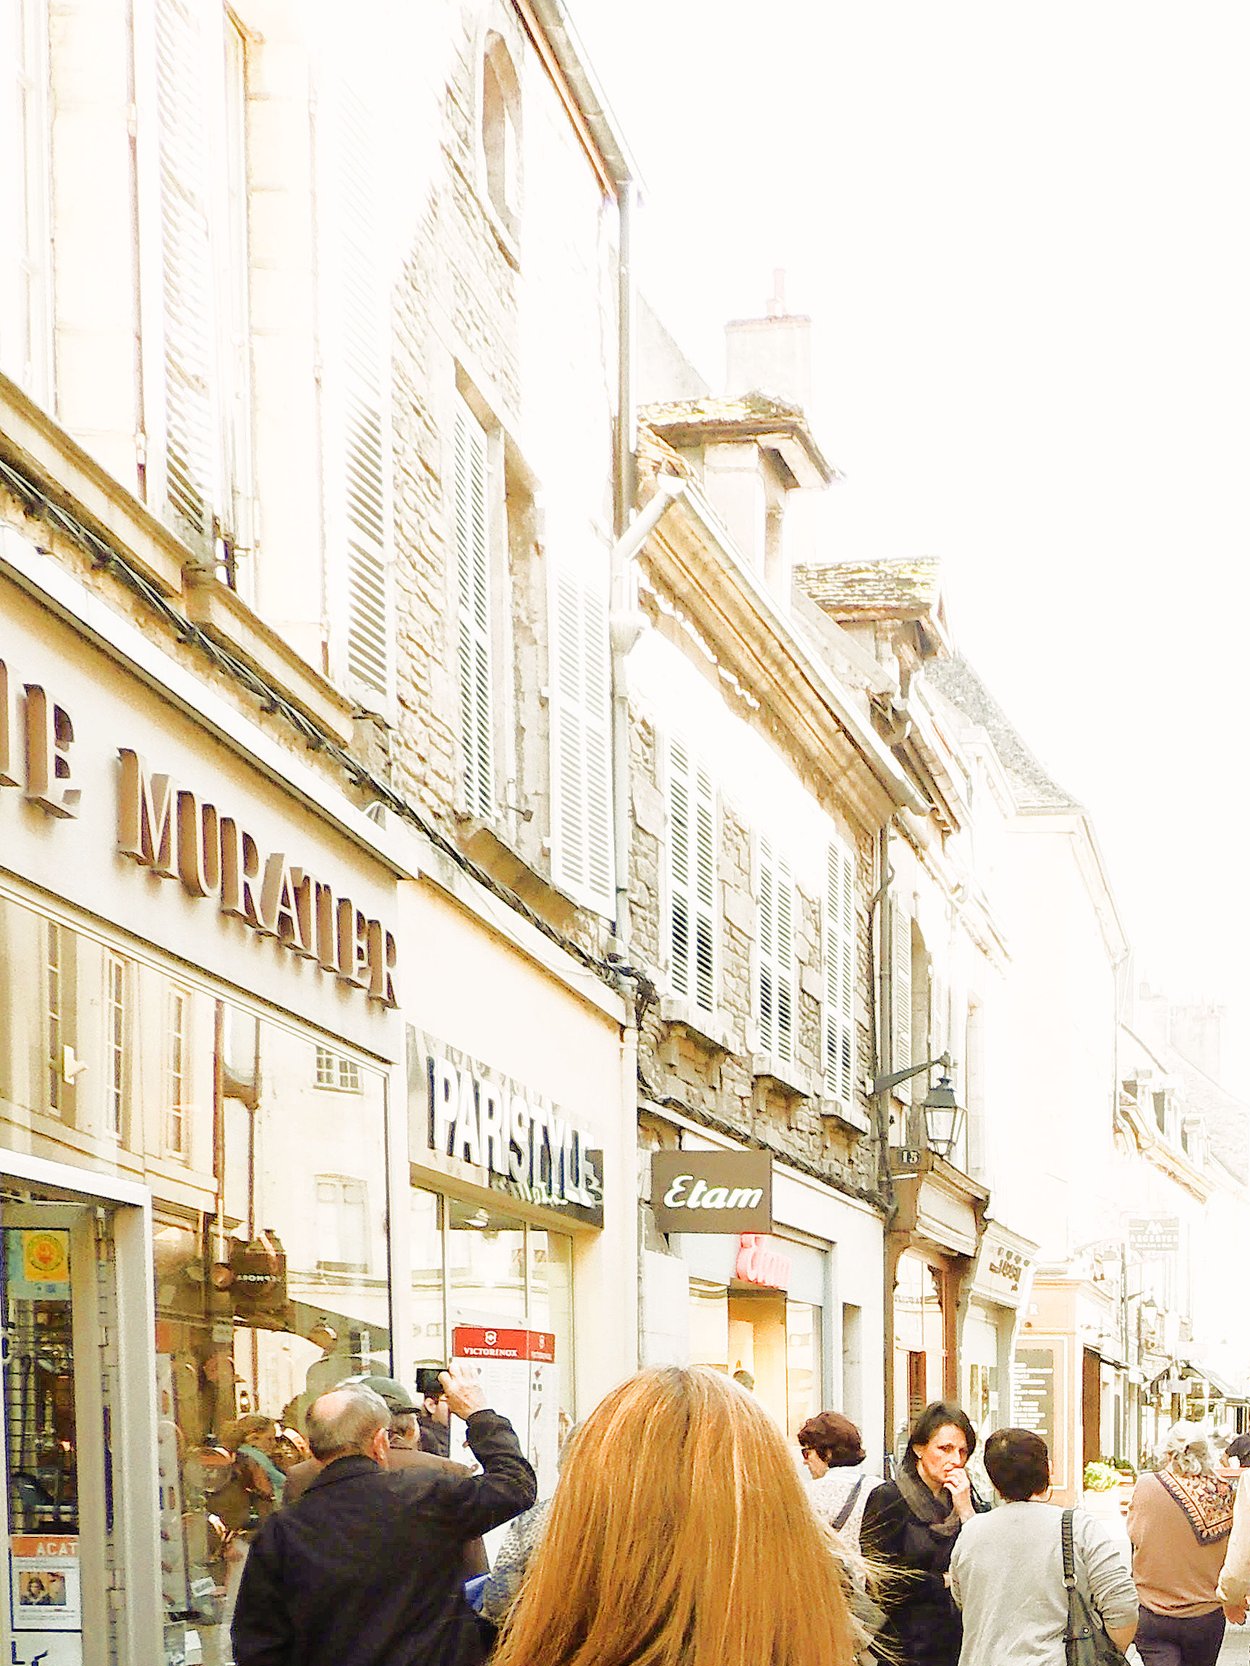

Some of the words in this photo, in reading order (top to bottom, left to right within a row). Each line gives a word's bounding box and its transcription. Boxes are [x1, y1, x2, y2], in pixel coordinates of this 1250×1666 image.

[117, 747, 399, 1009] MURATIER
[427, 1055, 602, 1209] PARISTYLE
[902, 1150, 919, 1164] 15
[663, 1174, 763, 1209] Etam
[463, 1346, 518, 1357] VICTORINOX
